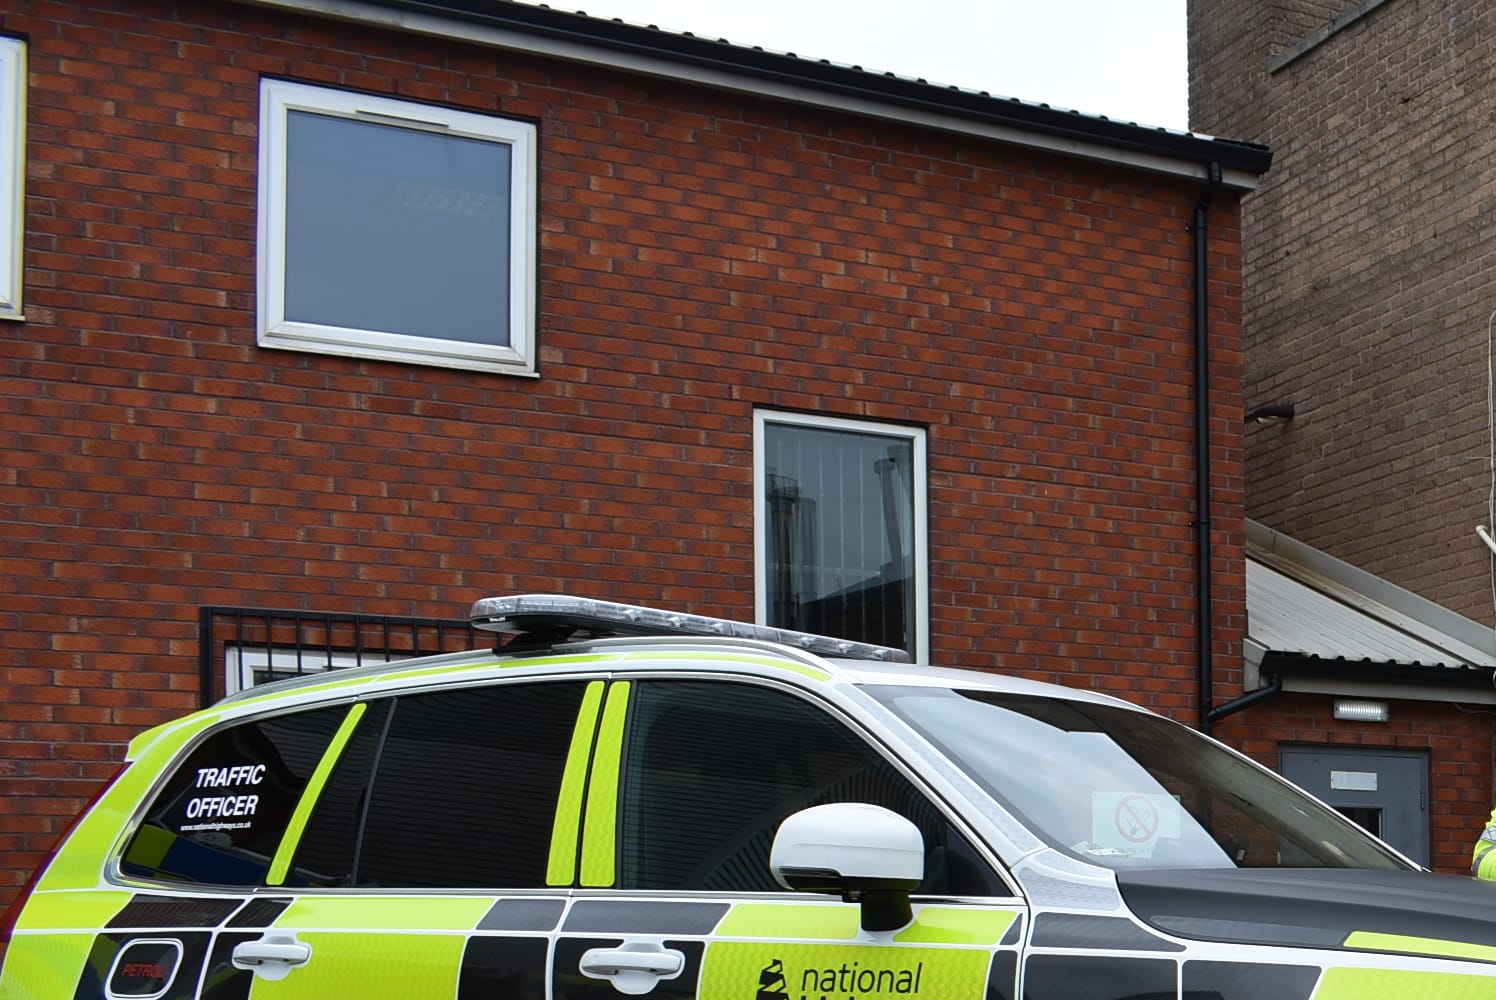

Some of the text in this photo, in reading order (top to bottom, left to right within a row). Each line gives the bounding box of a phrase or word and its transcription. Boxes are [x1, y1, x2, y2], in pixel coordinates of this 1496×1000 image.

[196, 764, 266, 788] TRAFFIC
[186, 795, 259, 818] OFFICER
[122, 963, 165, 977] PETROL
[801, 962, 922, 994] national
